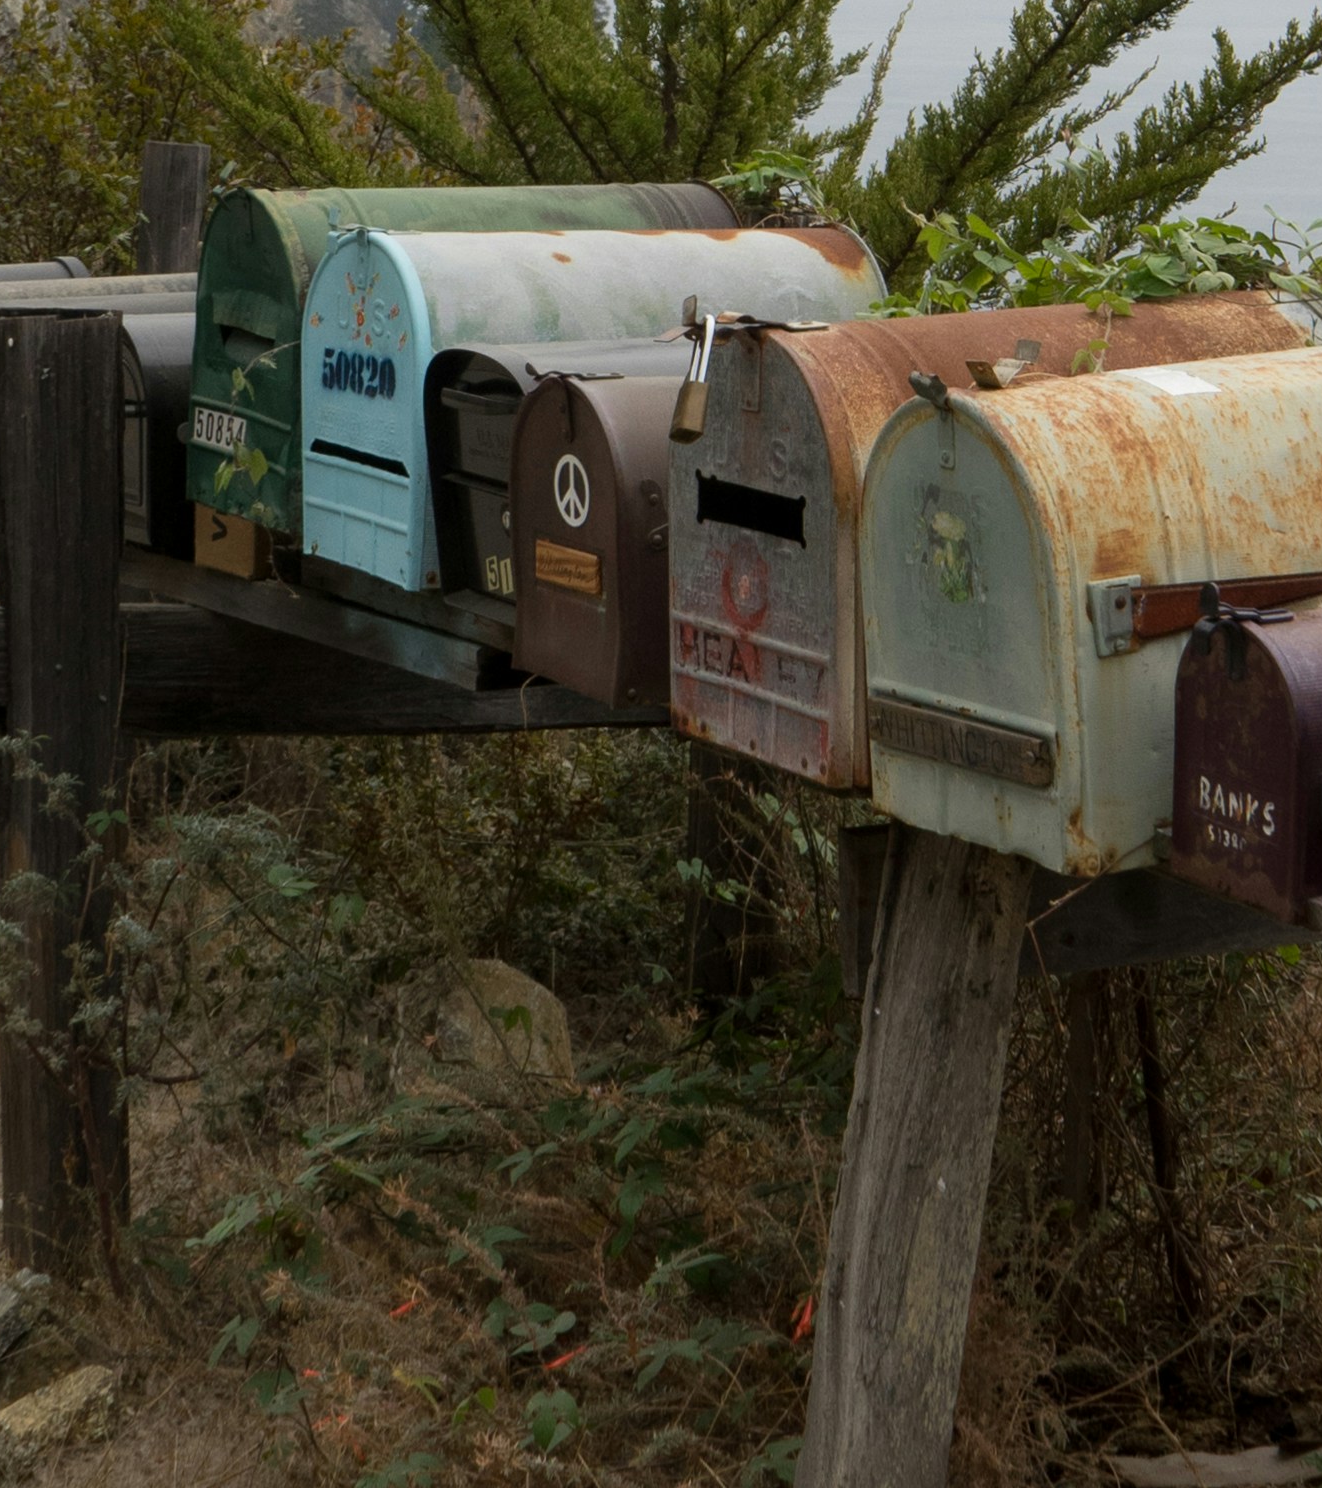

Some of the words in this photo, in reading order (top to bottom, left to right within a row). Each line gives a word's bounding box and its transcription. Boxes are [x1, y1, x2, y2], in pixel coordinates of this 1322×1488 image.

[322, 345, 397, 401] 50820
[195, 408, 245, 447] 50854
[679, 623, 826, 699] HEAEY
[1198, 774, 1277, 837] BANKS
